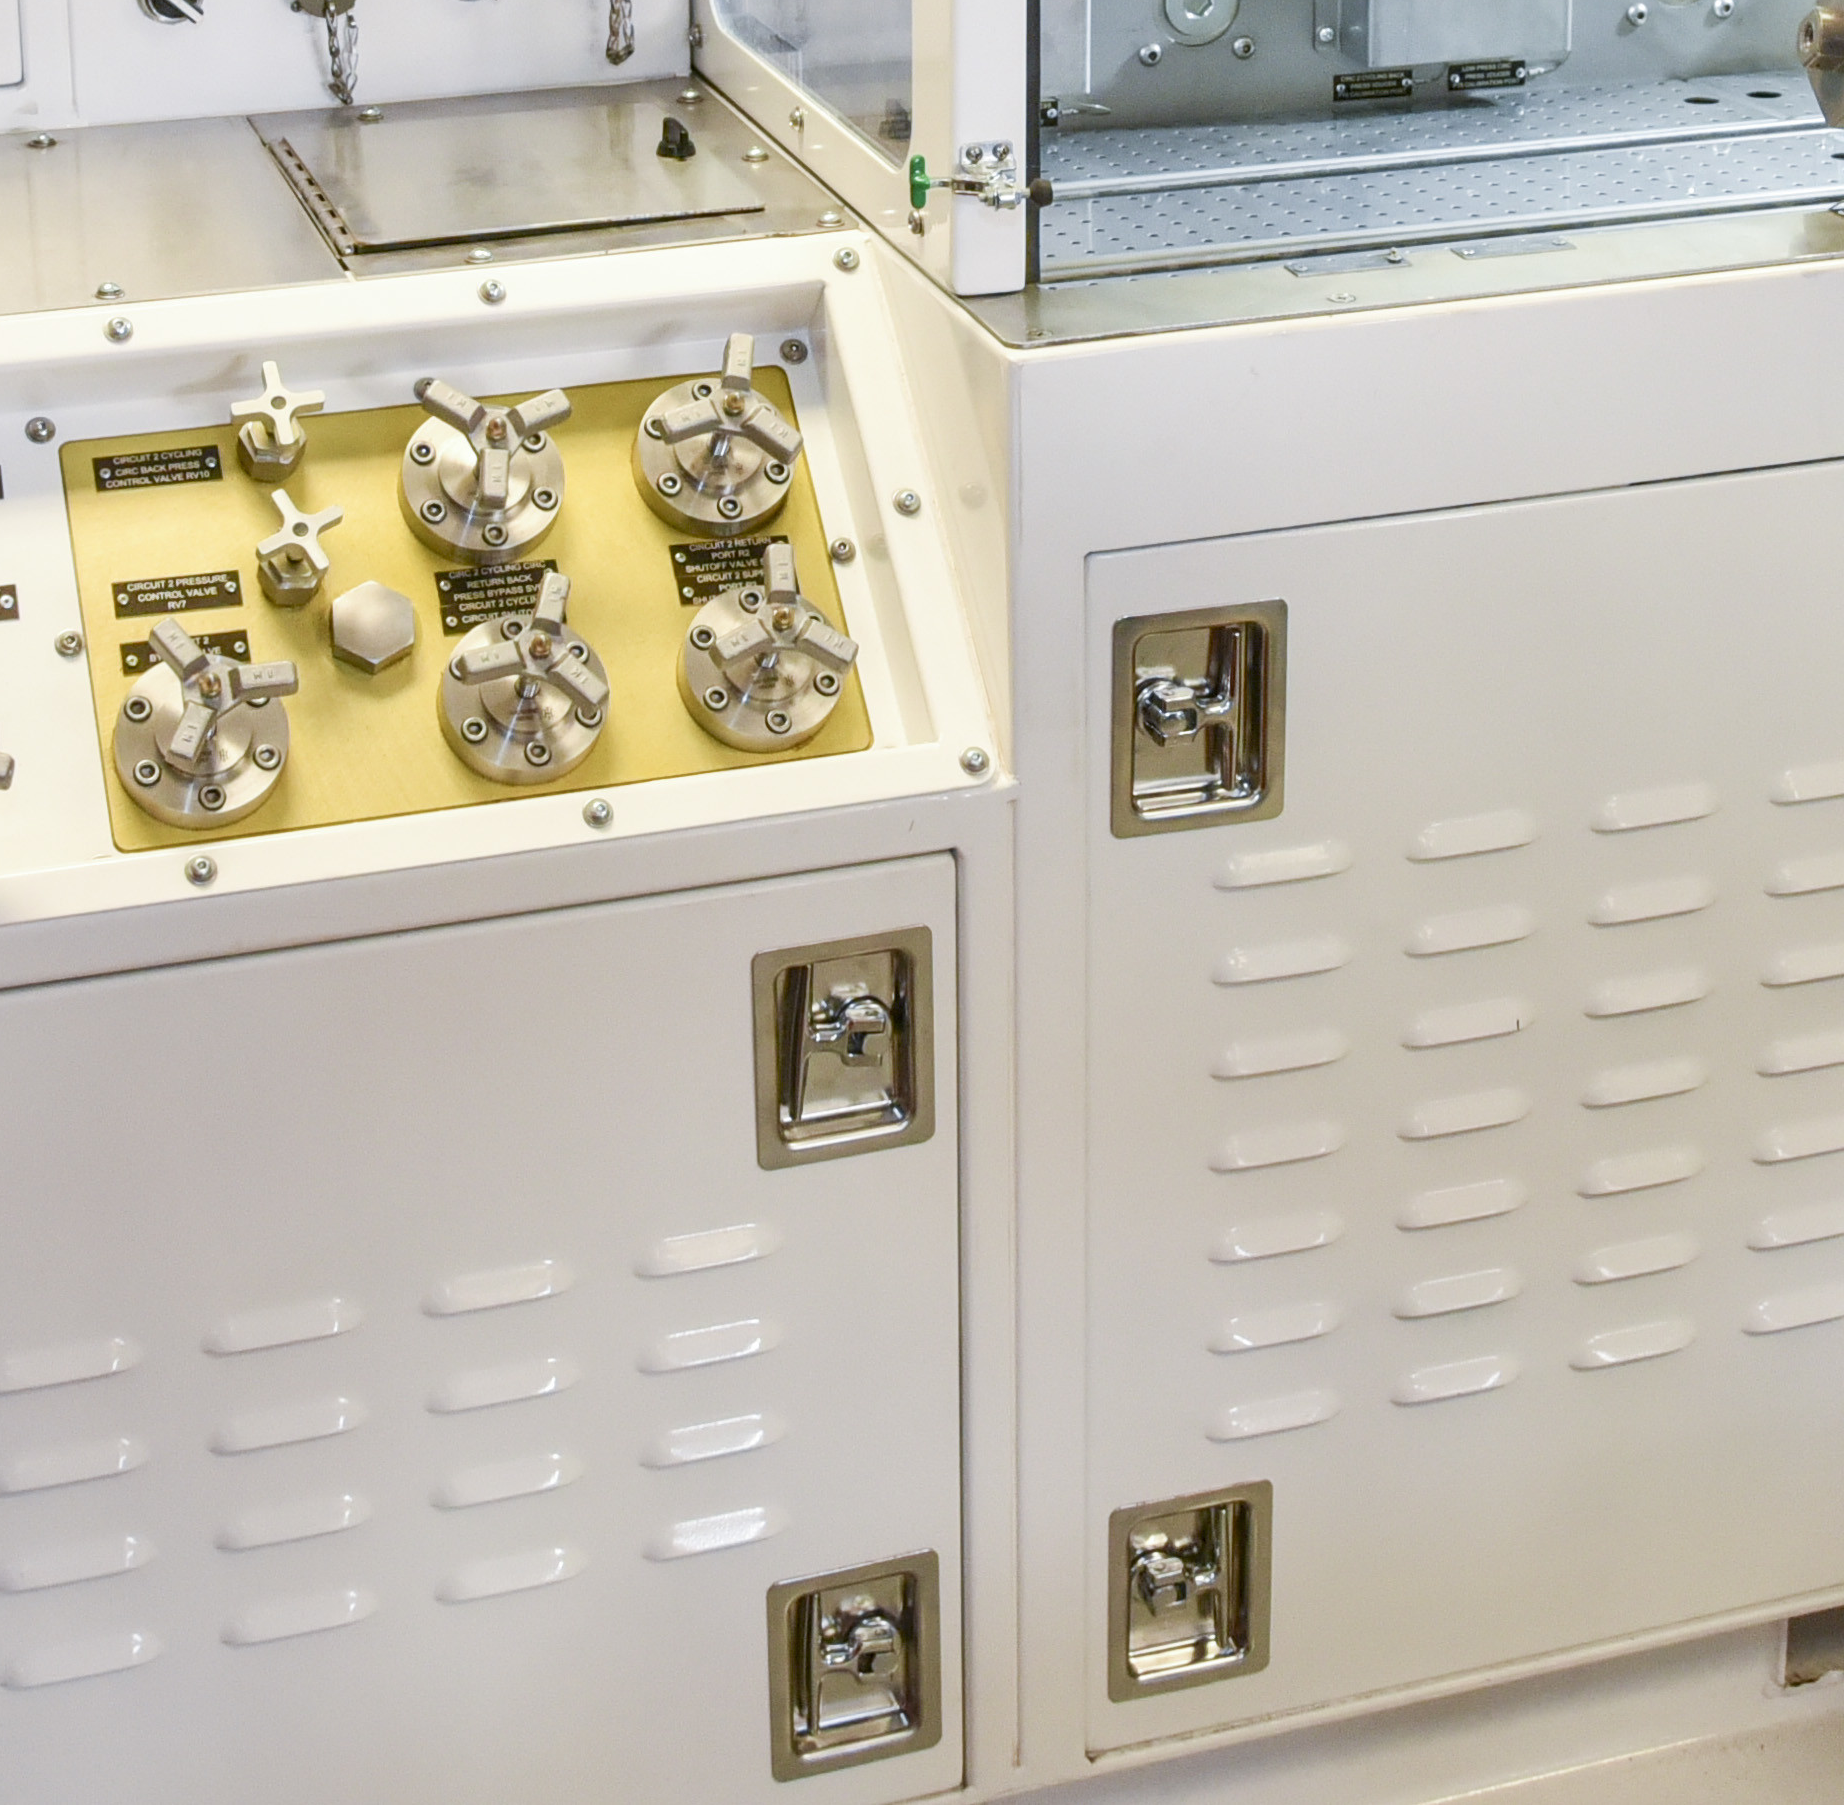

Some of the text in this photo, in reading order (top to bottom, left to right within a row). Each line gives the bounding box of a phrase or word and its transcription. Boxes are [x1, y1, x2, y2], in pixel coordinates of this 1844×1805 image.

[113, 454, 150, 464] CIRCUIT
[161, 449, 202, 460] CYCLING
[115, 461, 200, 477] CIRC BACK PRESS
[106, 471, 210, 489] CONTROL VALVE RV10
[127, 580, 165, 591] CIRCUIT
[176, 574, 227, 586] PRESSURE
[138, 587, 217, 602] CONTROL VALVE
[168, 601, 186, 609] RV7
